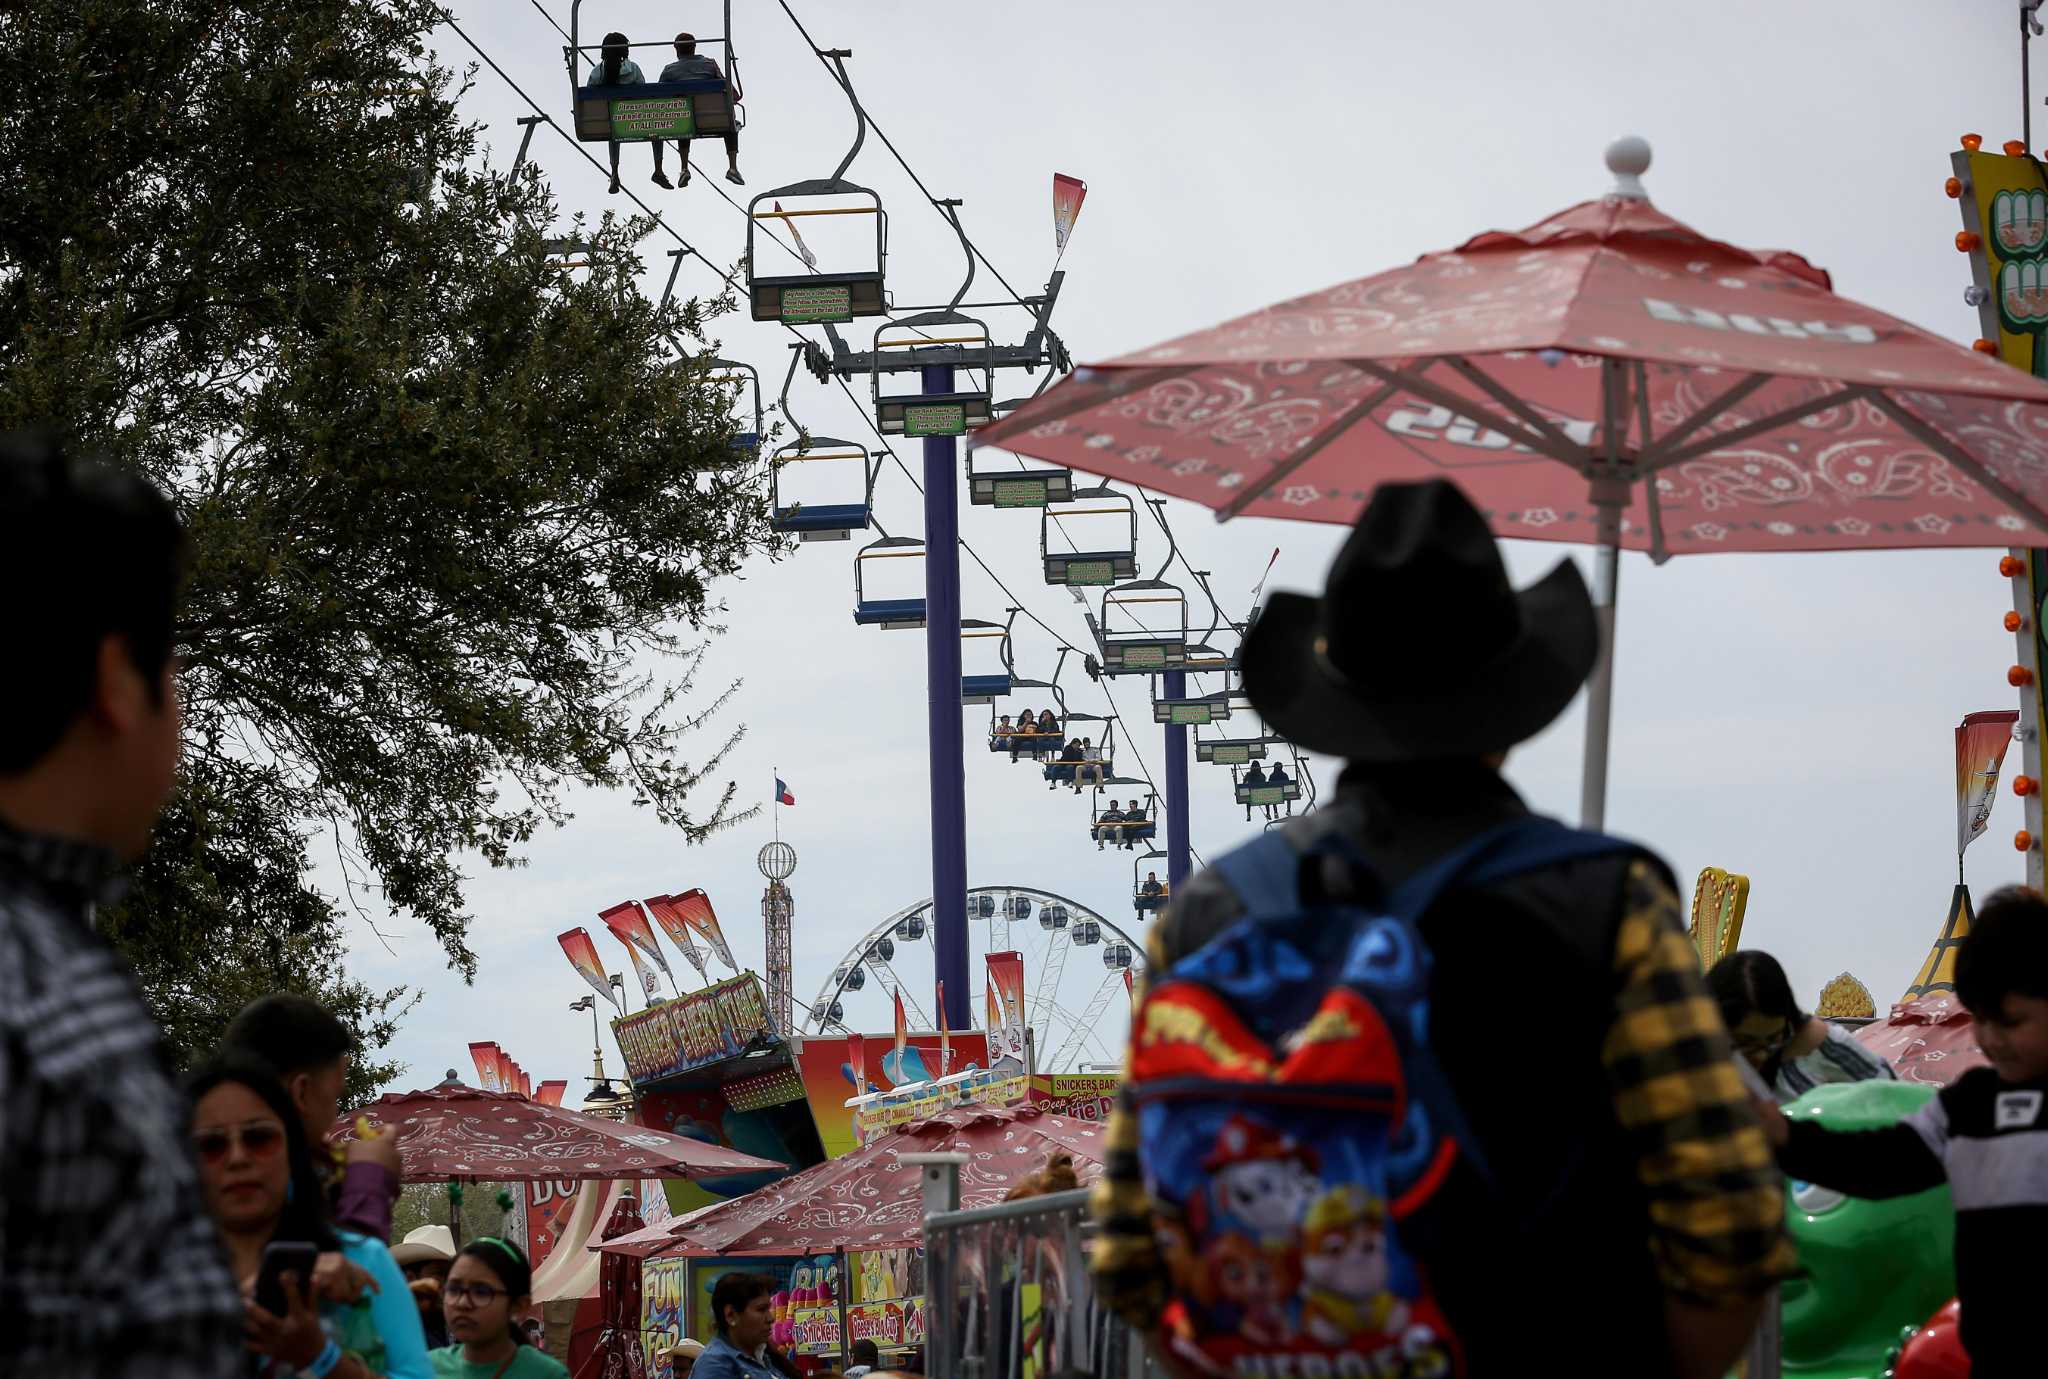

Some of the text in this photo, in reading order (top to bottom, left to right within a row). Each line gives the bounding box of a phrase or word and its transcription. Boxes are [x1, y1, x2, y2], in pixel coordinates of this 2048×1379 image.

[670, 995, 726, 1062] EVERY
[1056, 1079, 1120, 1091] SNICKERS BARS
[1039, 1088, 1099, 1112] Deep Fried
[643, 1268, 681, 1320] FUN
[802, 1320, 840, 1344] Snickers
[852, 1314, 875, 1340] Reese's
